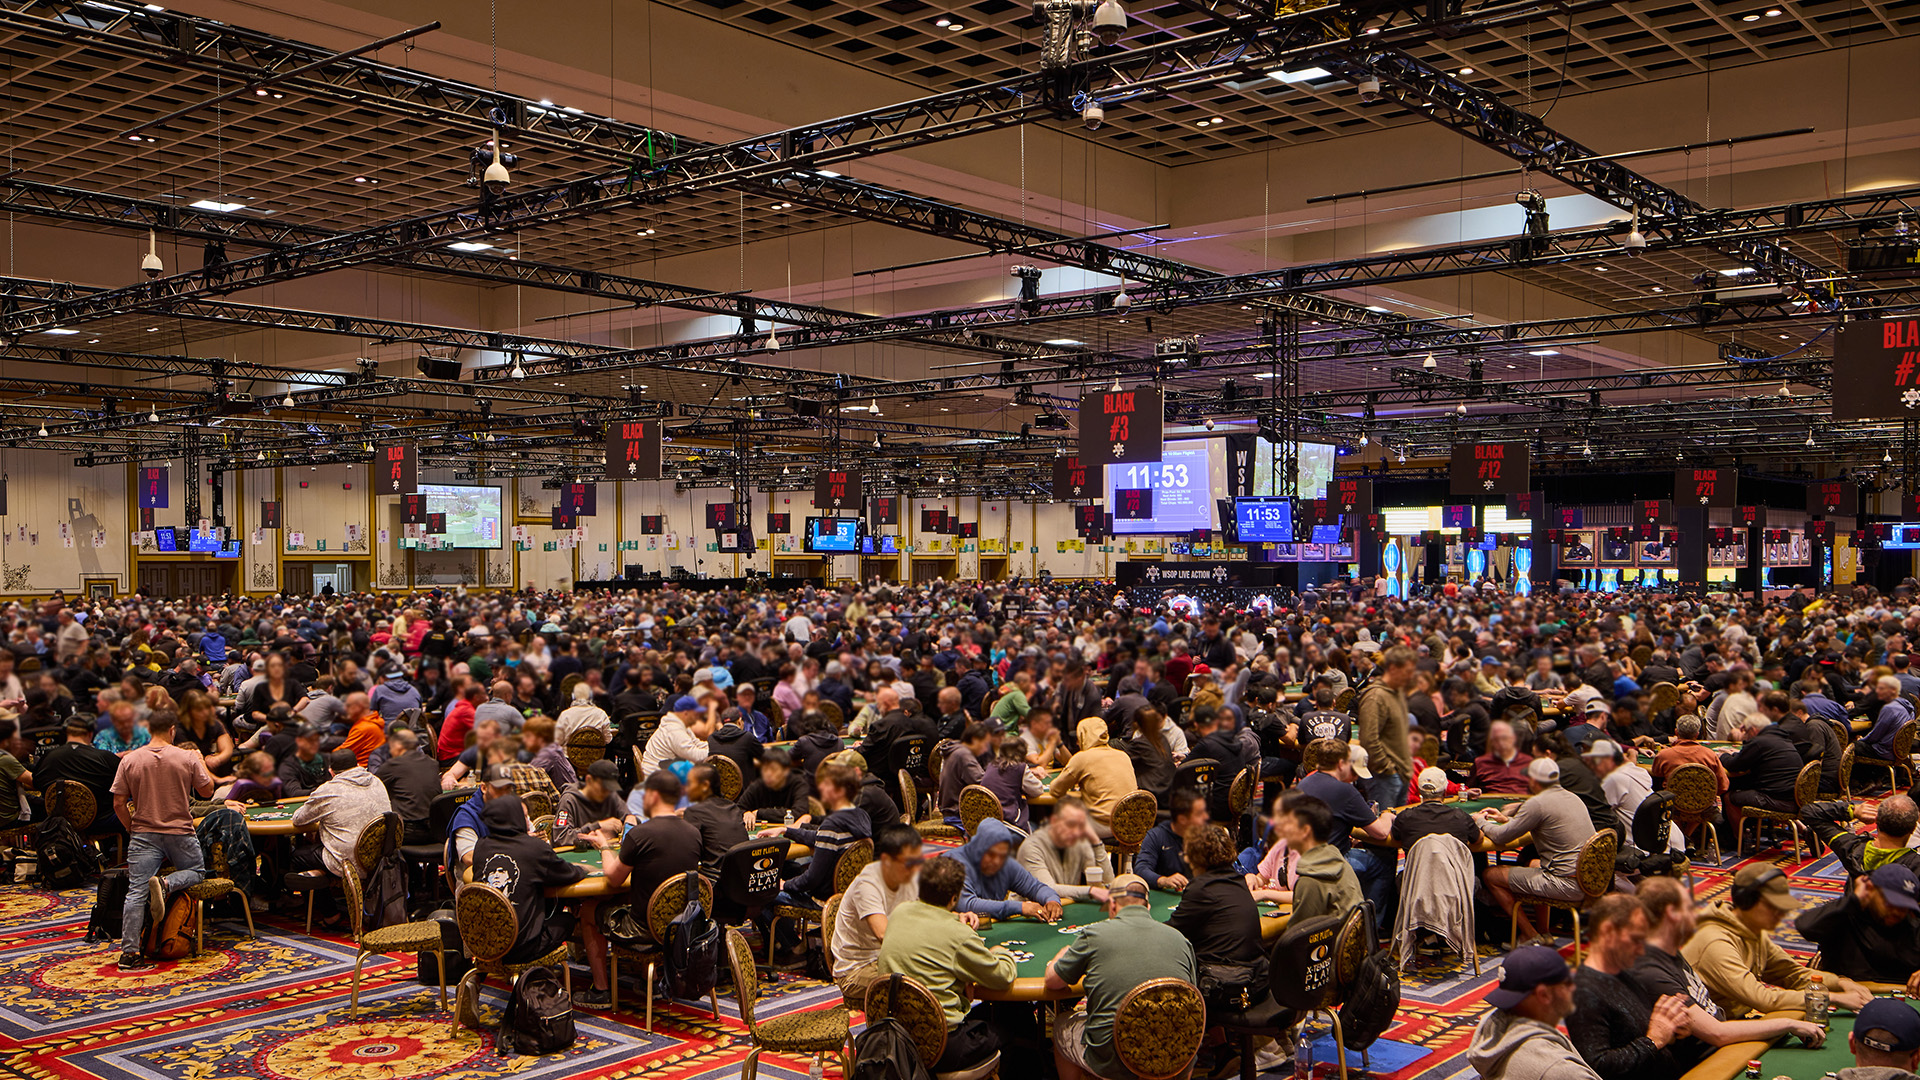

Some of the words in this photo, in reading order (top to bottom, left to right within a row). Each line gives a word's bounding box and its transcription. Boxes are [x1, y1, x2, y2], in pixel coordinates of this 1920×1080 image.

[1883, 320, 1920, 349] BLA
[1104, 392, 1135, 413] BLACK
[623, 423, 643, 439] BLACK
[1110, 415, 1128, 441] #3
[388, 447, 404, 460] BLACK
[626, 441, 640, 460] #4
[1475, 445, 1504, 459] BLACK
[1068, 458, 1087, 469] BLA
[1478, 461, 1500, 478] #12
[148, 469, 159, 479] BLACK
[392, 462, 401, 479] #5
[1127, 464, 1189, 488] 11:53
[1236, 450, 1248, 496] WSO
[1694, 470, 1717, 480] BLACK
[829, 472, 847, 483] BLACK
[1070, 470, 1086, 486] #13
[572, 484, 585, 493] BLACK
[831, 485, 845, 497] #14
[1340, 481, 1357, 491] BLACK
[1696, 482, 1714, 495] #21
[1822, 484, 1841, 493] BLACK
[573, 495, 583, 505] #15
[1126, 490, 1140, 498] BLACK
[1341, 492, 1356, 504] #22
[1824, 494, 1840, 505] #30
[1127, 499, 1139, 510] #23
[1246, 508, 1280, 521] 11:53
[1646, 509, 1658, 517] #40
[1162, 570, 1178, 579] WSOP
[1178, 570, 1190, 579] LIVE
[1190, 570, 1210, 579] ACTION
[1308, 716, 1325, 726] GET
[1330, 716, 1342, 726] TO
[752, 848, 762, 856] GARY
[762, 846, 775, 855] PLATT
[750, 868, 778, 880] X-TENDED
[748, 874, 778, 887] PLAY
[1306, 966, 1330, 984] PLAY
